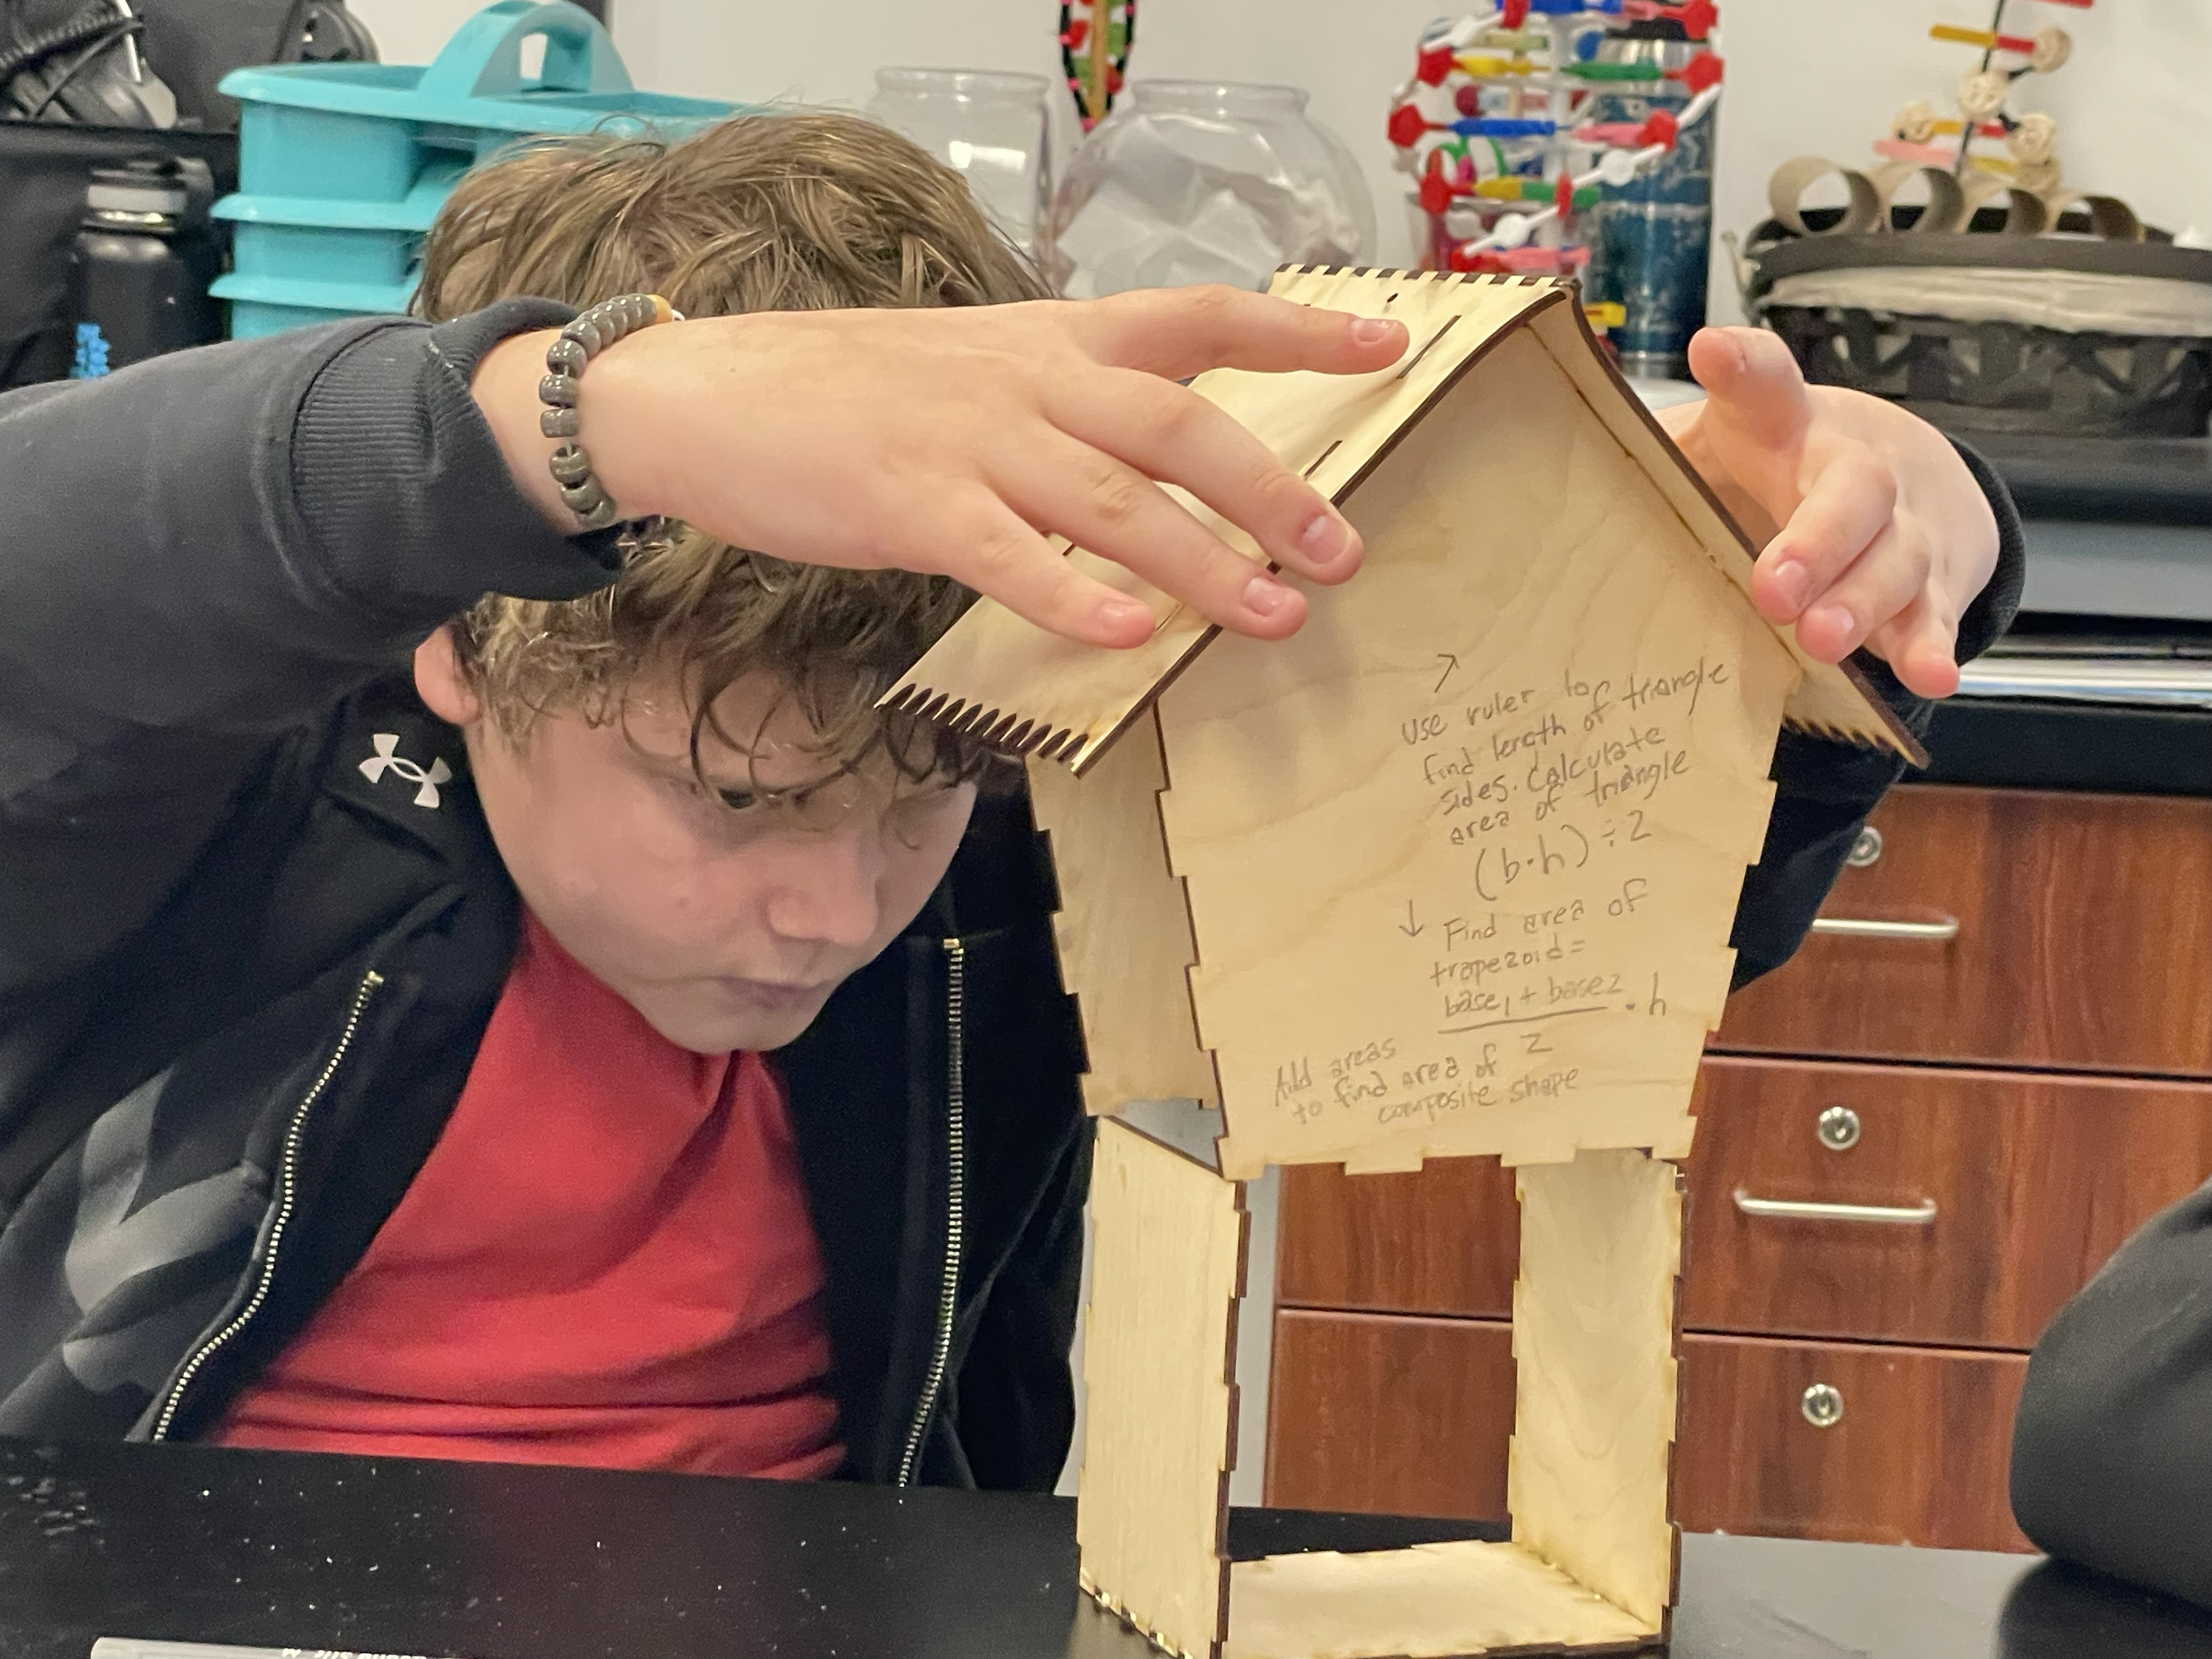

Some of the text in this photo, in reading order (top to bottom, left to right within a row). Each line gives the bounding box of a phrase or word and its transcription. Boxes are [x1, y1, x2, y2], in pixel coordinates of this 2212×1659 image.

[1401, 714, 1448, 745] Use
[1466, 689, 1536, 726] ruler
[1492, 713, 1566, 772] length
[1583, 680, 1611, 732] of
[1622, 656, 1729, 716] triangle
[1527, 727, 1666, 792] Calculate
[1449, 750, 1691, 845] area of triangle
[1627, 809, 1652, 842] 2
[1443, 878, 1648, 951] Find area of
[1274, 1037, 1397, 1106] Add areas
[1293, 1042, 1497, 1124] to find area of
[1378, 1068, 1579, 1124] composite shape
